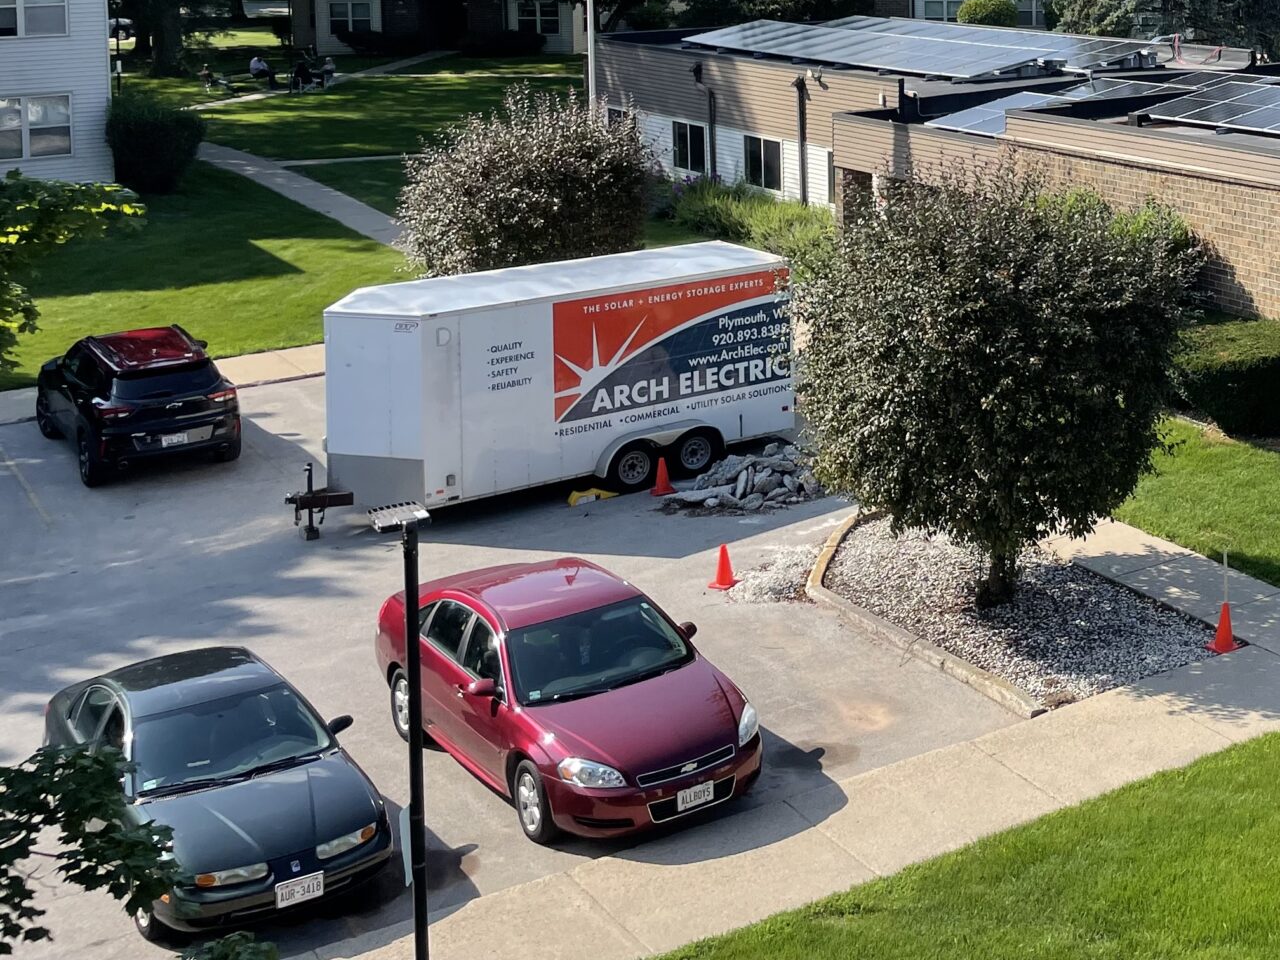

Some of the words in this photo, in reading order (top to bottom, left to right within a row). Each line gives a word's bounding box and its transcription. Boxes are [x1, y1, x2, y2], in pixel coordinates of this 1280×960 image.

[583, 305, 601, 314] THE
[604, 299, 634, 311] SOLAR
[648, 292, 683, 304] ENERGY
[686, 285, 726, 298] STORAGE
[729, 279, 764, 291] EXPERTS
[718, 309, 770, 330] Plymouth,
[490, 341, 523, 353] QUALITY
[688, 341, 788, 367] www.ArchElec.com
[490, 351, 535, 366] EXPERIENCE
[491, 366, 518, 378] SAFETY
[491, 377, 532, 391] RELIABILITY
[591, 377, 670, 413] ARCH
[679, 355, 788, 395] ELECTRIC
[559, 419, 613, 437] RESIDENTIAL
[624, 406, 680, 424] COMMERCIAL
[690, 398, 719, 410] UTILITY
[720, 392, 746, 405] SOLAR
[748, 383, 791, 399] SOLUTIONS
[681, 786, 711, 806] ALLBOYS
[280, 880, 321, 903] AUR-3418
